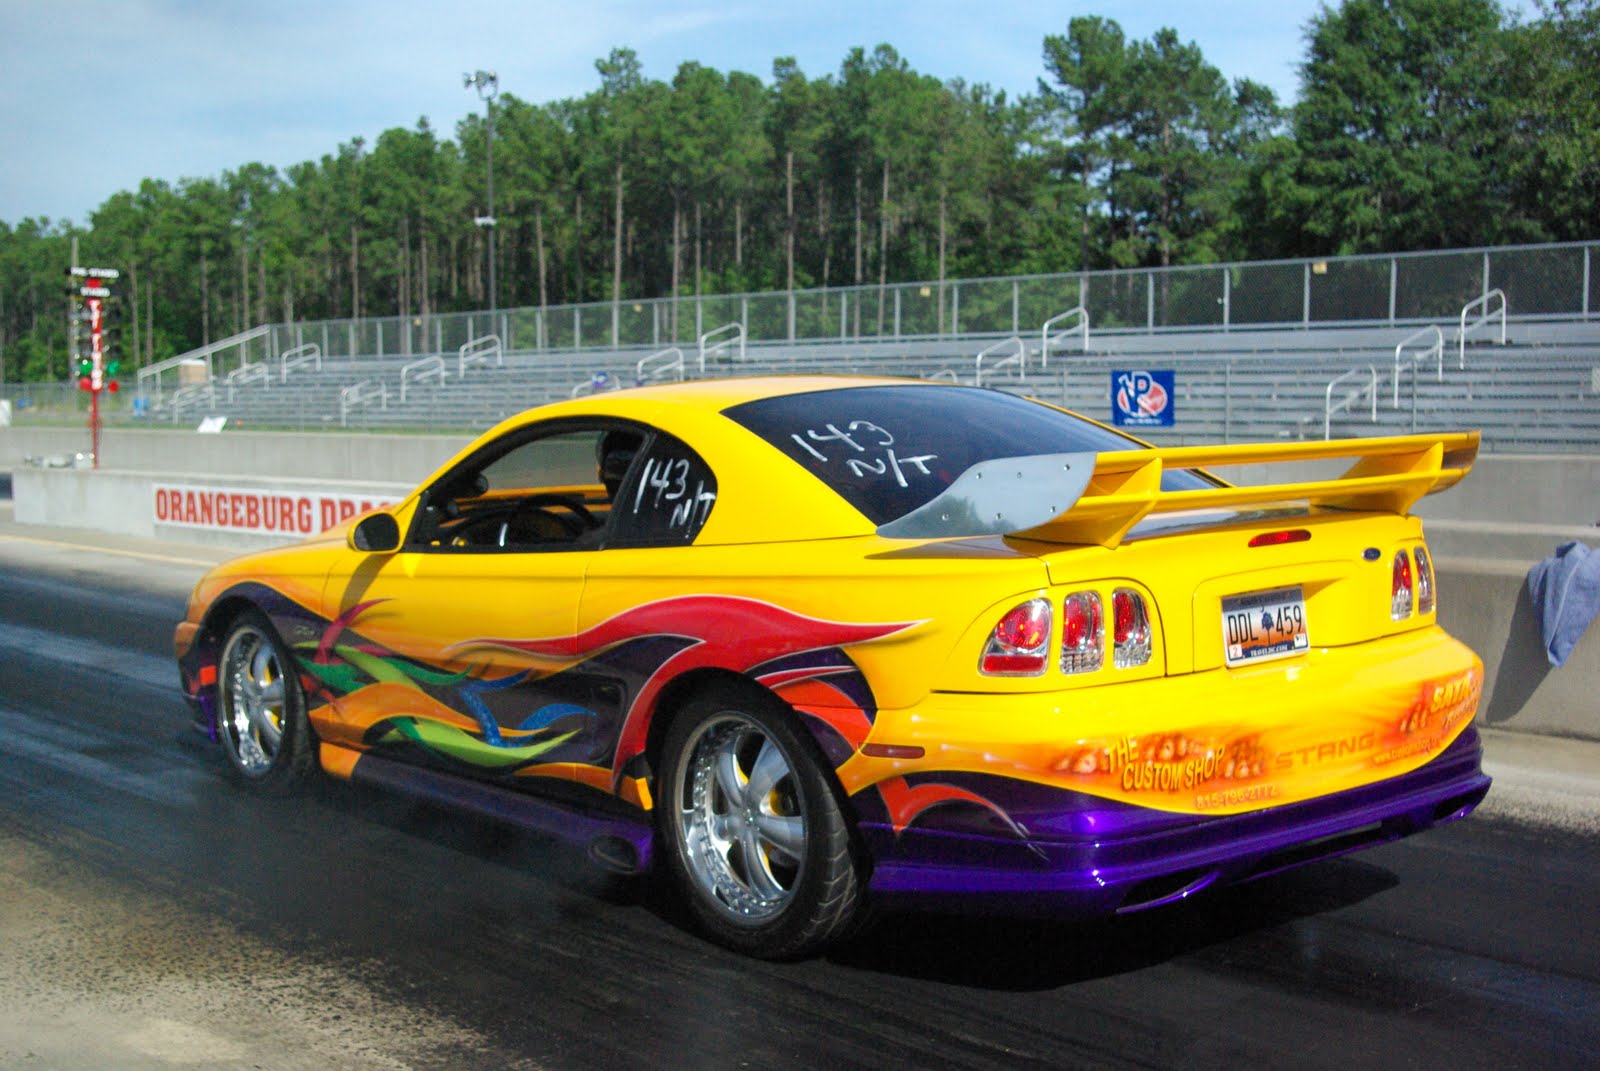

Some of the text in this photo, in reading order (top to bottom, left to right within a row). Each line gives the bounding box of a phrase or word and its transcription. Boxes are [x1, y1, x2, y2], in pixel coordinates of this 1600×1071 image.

[791, 420, 894, 462] 143
[633, 457, 691, 514] 143
[155, 488, 312, 534] ORANGEBURG
[1228, 605, 1302, 645] DDL 459
[1107, 734, 1140, 774] THE
[1122, 746, 1225, 792] CUSTOM SHOP
